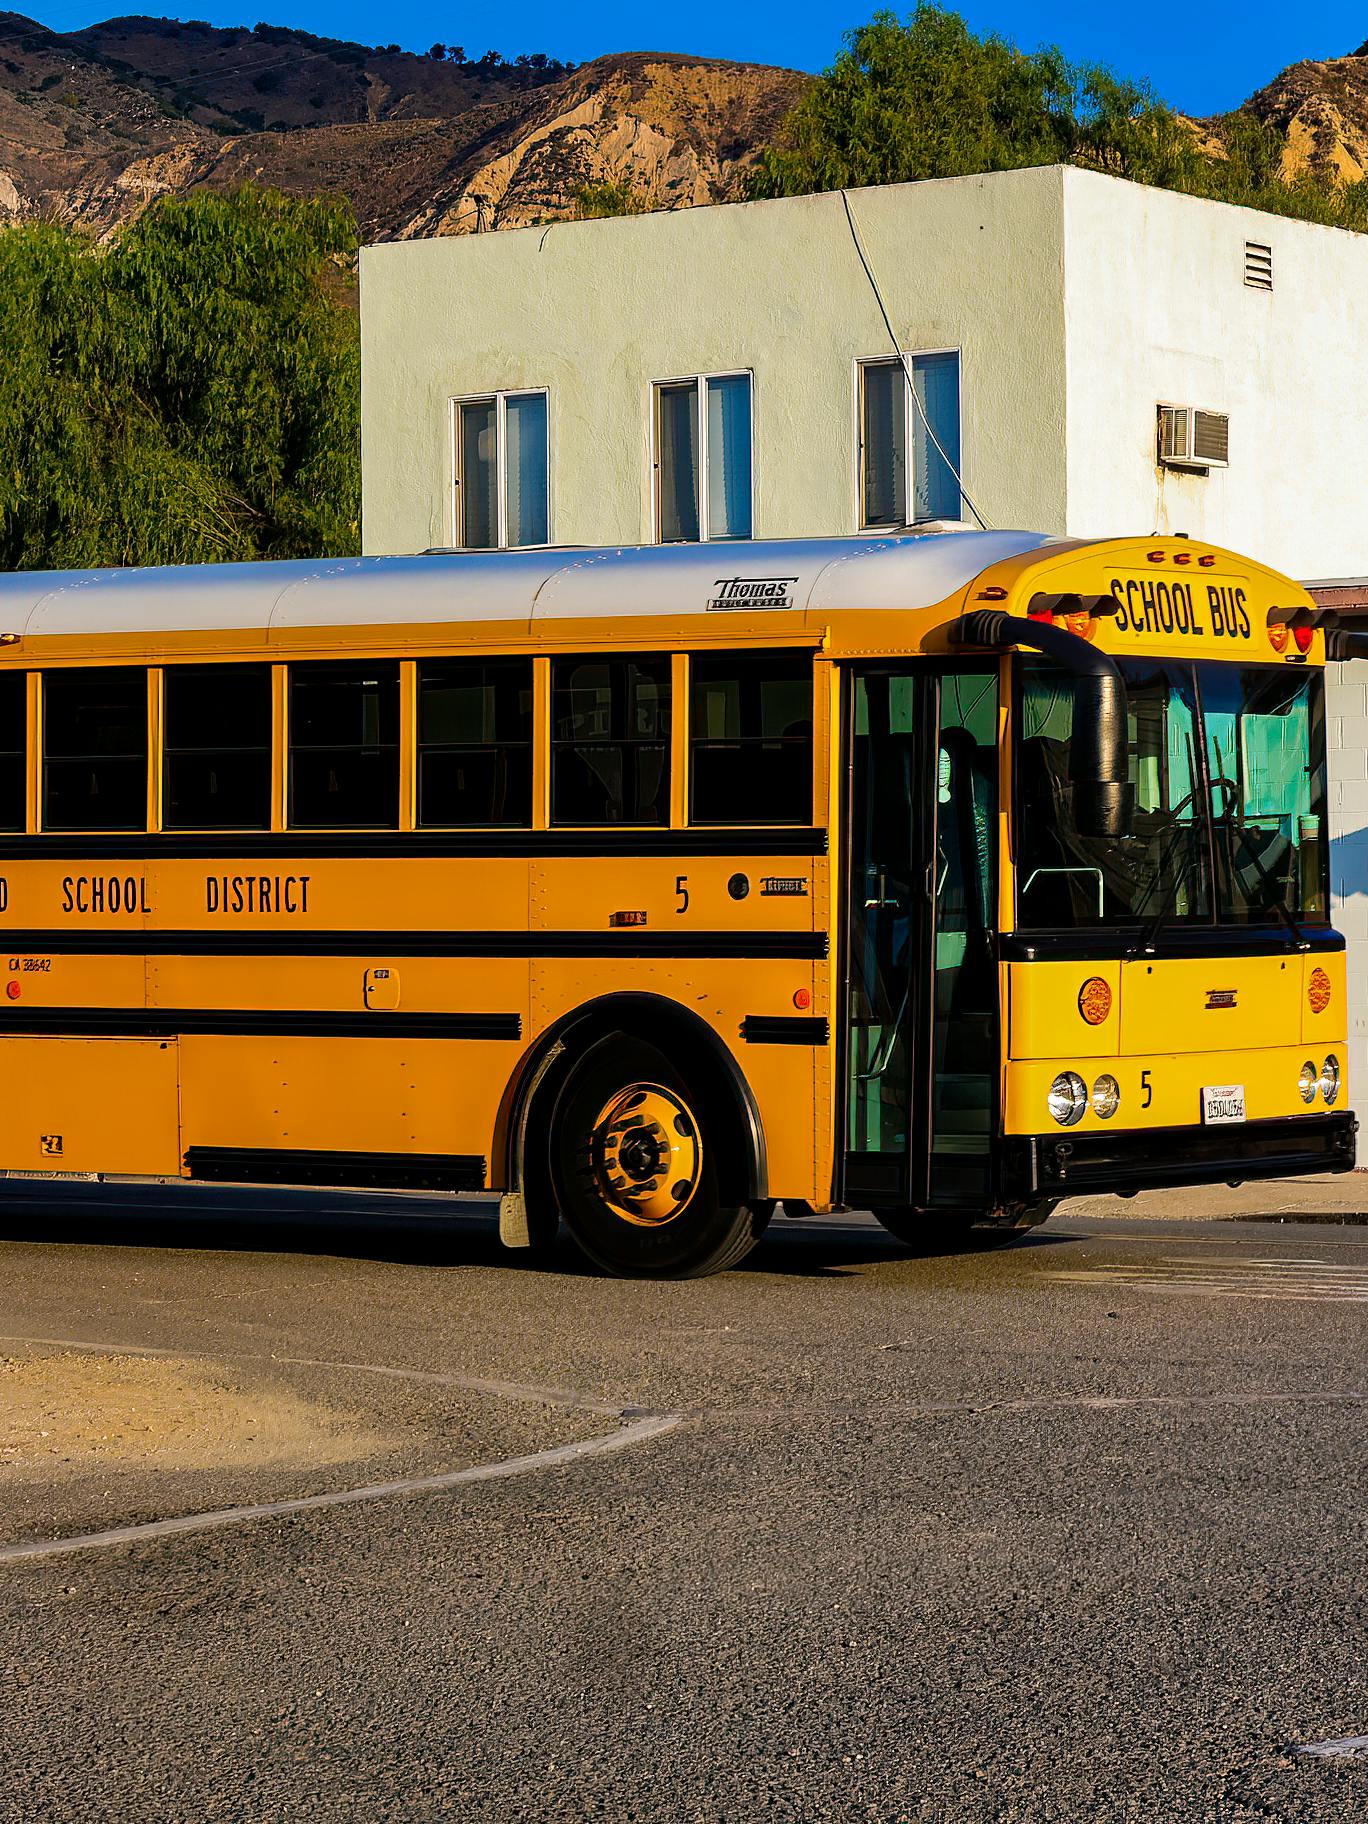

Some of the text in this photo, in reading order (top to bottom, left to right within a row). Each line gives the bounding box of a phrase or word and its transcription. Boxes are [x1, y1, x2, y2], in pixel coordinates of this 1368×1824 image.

[714, 577, 799, 599] Thomas
[1111, 579, 1250, 639] SCHOOL BUS
[62, 877, 151, 913] SCHOOL
[207, 876, 310, 912] DISTRICT
[675, 876, 689, 913] 5
[9, 958, 21, 971] CA
[1141, 1070, 1152, 1108] 5
